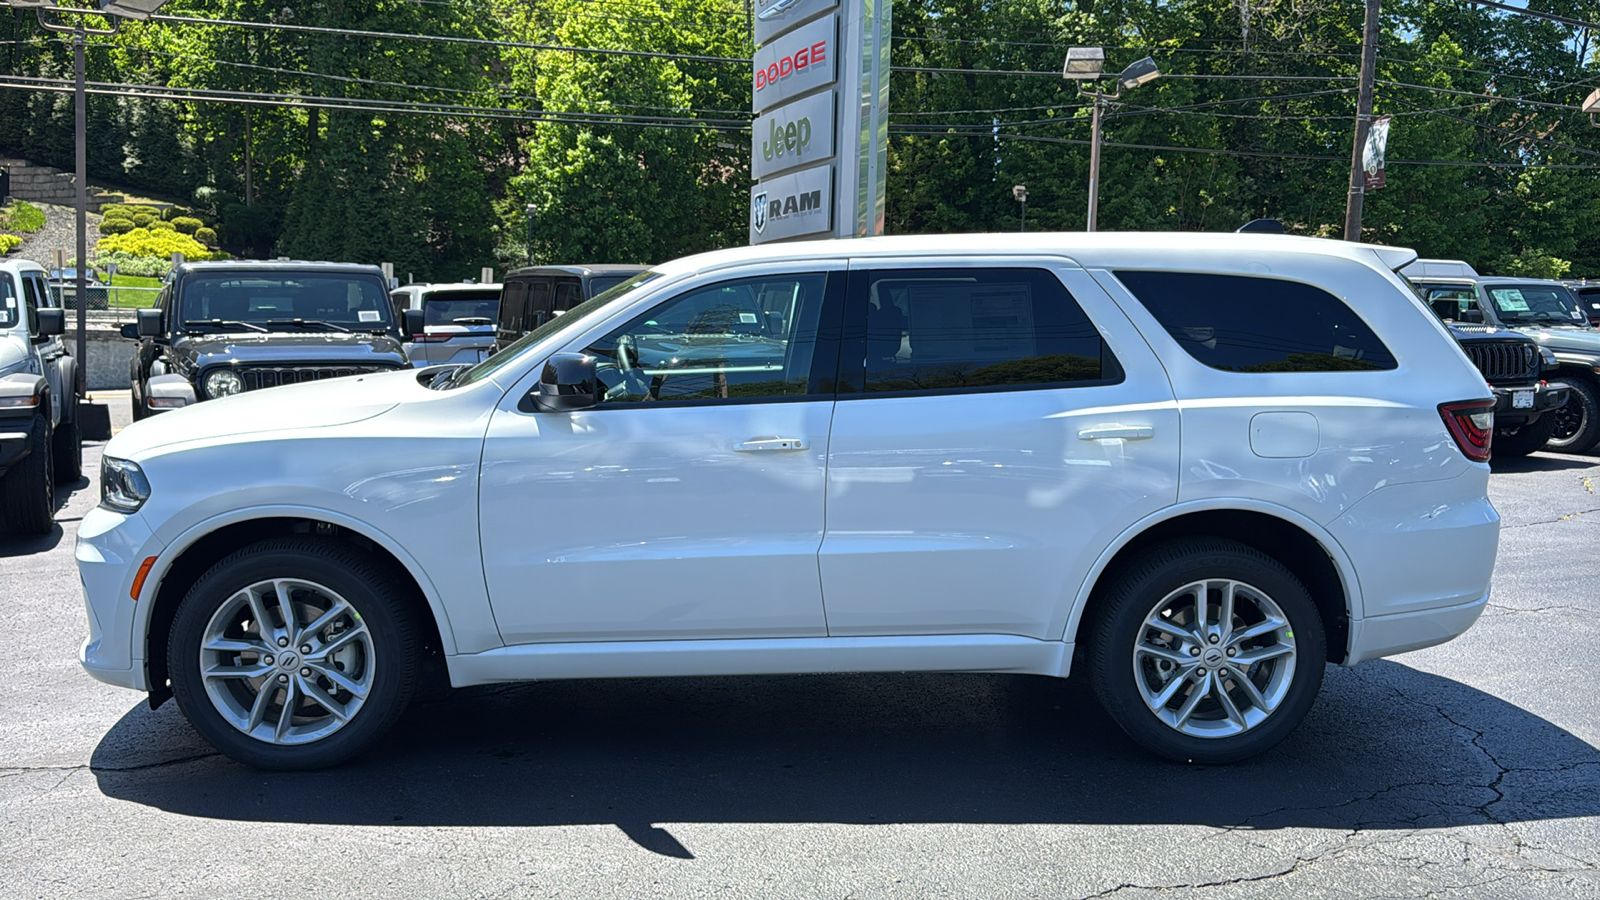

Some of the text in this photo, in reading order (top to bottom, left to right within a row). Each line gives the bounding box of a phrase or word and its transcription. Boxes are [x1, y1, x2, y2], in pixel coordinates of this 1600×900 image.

[756, 41, 826, 90] DODGE
[763, 117, 811, 160] Jeep
[769, 190, 821, 219] RAM
